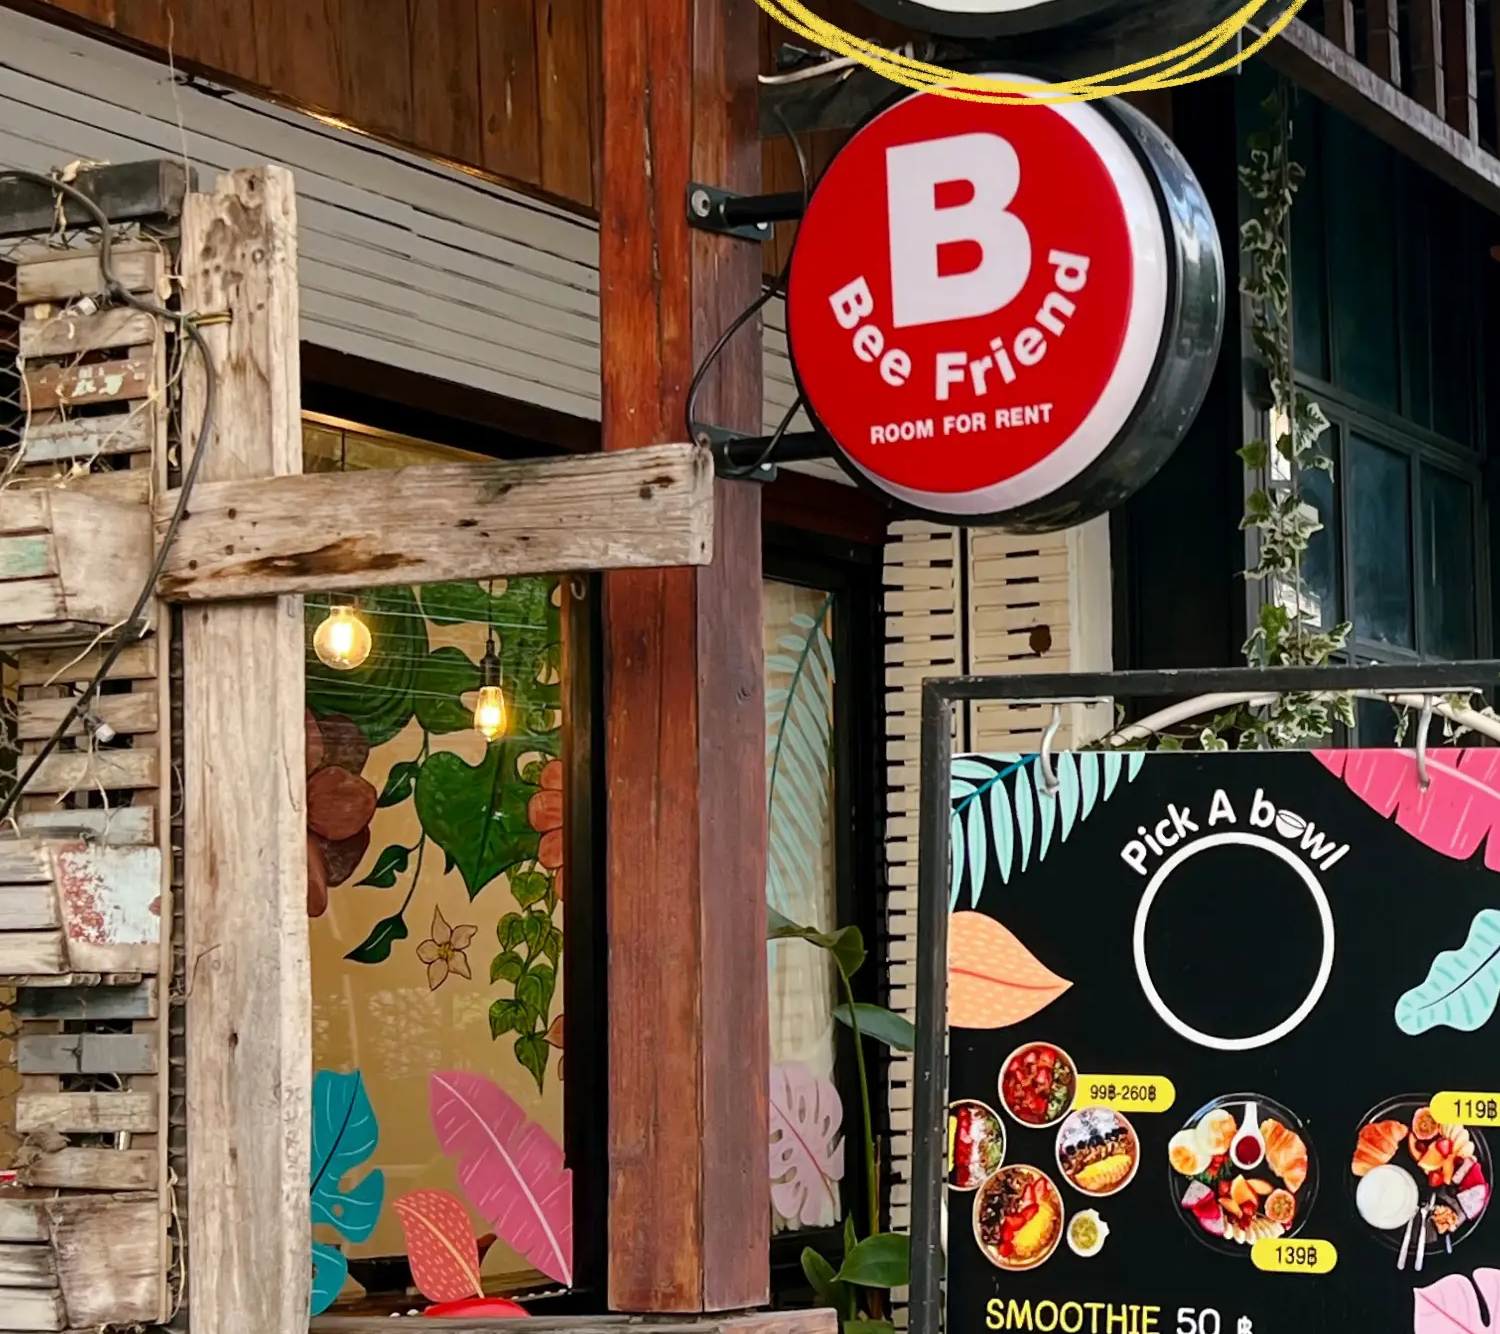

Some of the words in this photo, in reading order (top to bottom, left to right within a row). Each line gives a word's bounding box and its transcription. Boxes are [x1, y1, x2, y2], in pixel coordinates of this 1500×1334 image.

[886, 132, 1032, 328] B
[828, 275, 912, 386] Bee
[935, 249, 1090, 401] Friend
[870, 420, 934, 445] ROOM
[943, 412, 986, 436] FOR
[995, 403, 1053, 428] RENT
[1120, 803, 1199, 875] Pick
[1208, 789, 1237, 826] A
